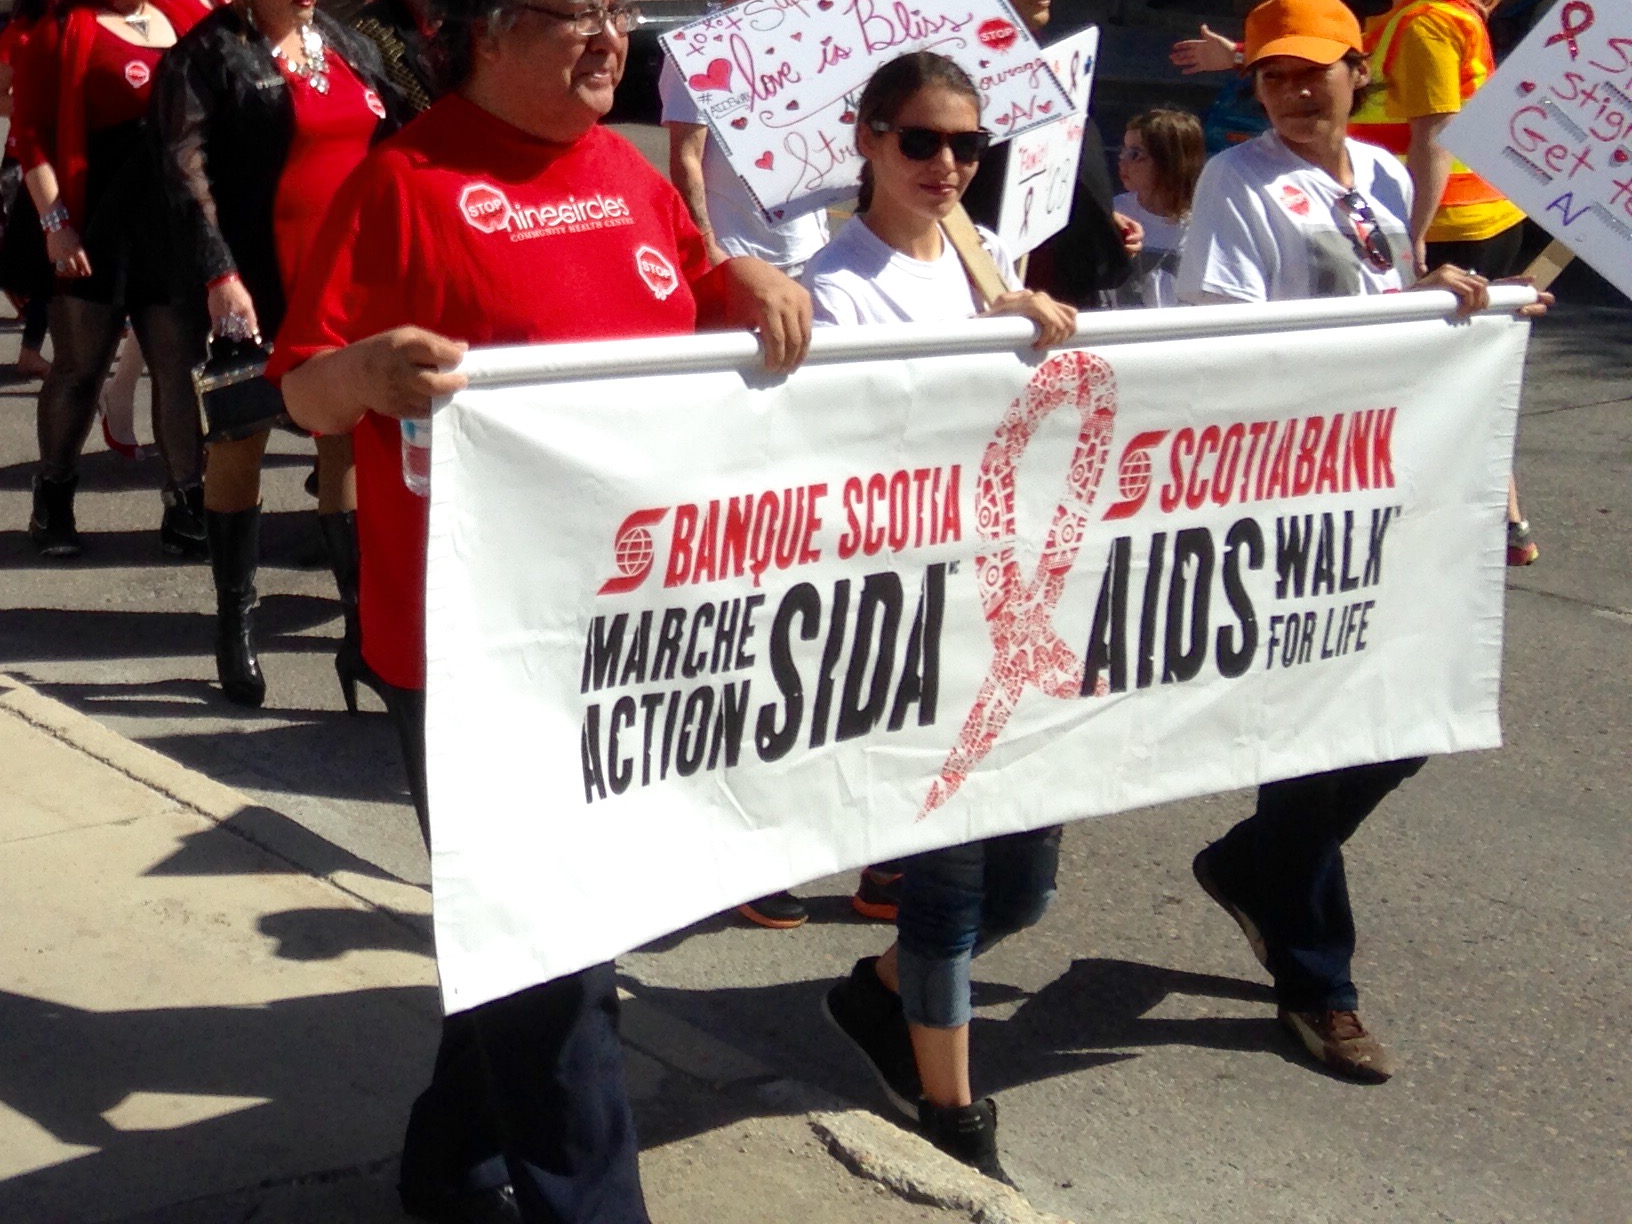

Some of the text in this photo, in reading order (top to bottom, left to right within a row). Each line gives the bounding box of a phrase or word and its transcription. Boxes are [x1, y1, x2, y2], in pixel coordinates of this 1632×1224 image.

[817, 35, 853, 74] is
[978, 27, 1014, 43] STOP
[1509, 105, 1596, 179] Get
[1549, 71, 1632, 142] Stig
[467, 197, 503, 219] STOP
[640, 259, 672, 277] STOP
[1159, 406, 1398, 514] SCOTIABANK
[662, 463, 963, 588] BANQUE SCOTIA
[1274, 506, 1392, 600] WALK
[580, 594, 766, 695] MARCHE
[1079, 516, 1267, 698] AIDS
[1265, 600, 1376, 672] FOR LIFE
[754, 561, 948, 764] SIDA
[580, 678, 752, 804] ACTION
